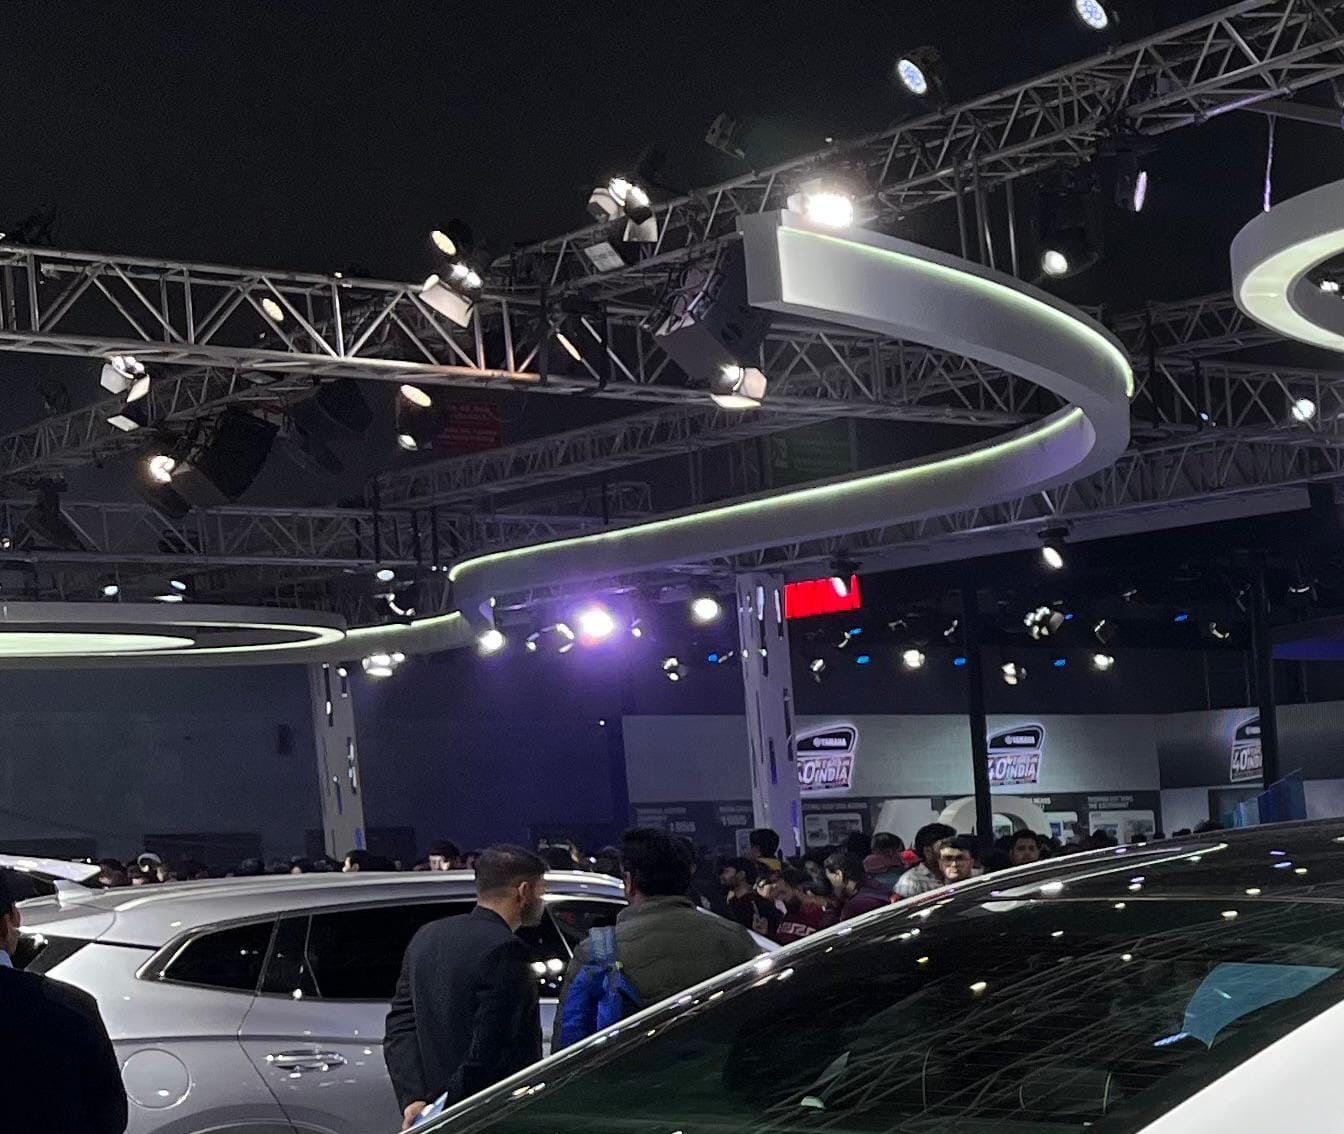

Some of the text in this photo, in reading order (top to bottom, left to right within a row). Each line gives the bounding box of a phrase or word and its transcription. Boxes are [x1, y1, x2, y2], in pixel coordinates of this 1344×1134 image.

[820, 737, 847, 747] YAMAHA
[1012, 735, 1036, 744] YAMAHA
[1232, 748, 1248, 772] 40
[815, 766, 848, 784] INDIA
[1006, 763, 1035, 780] INDIA
